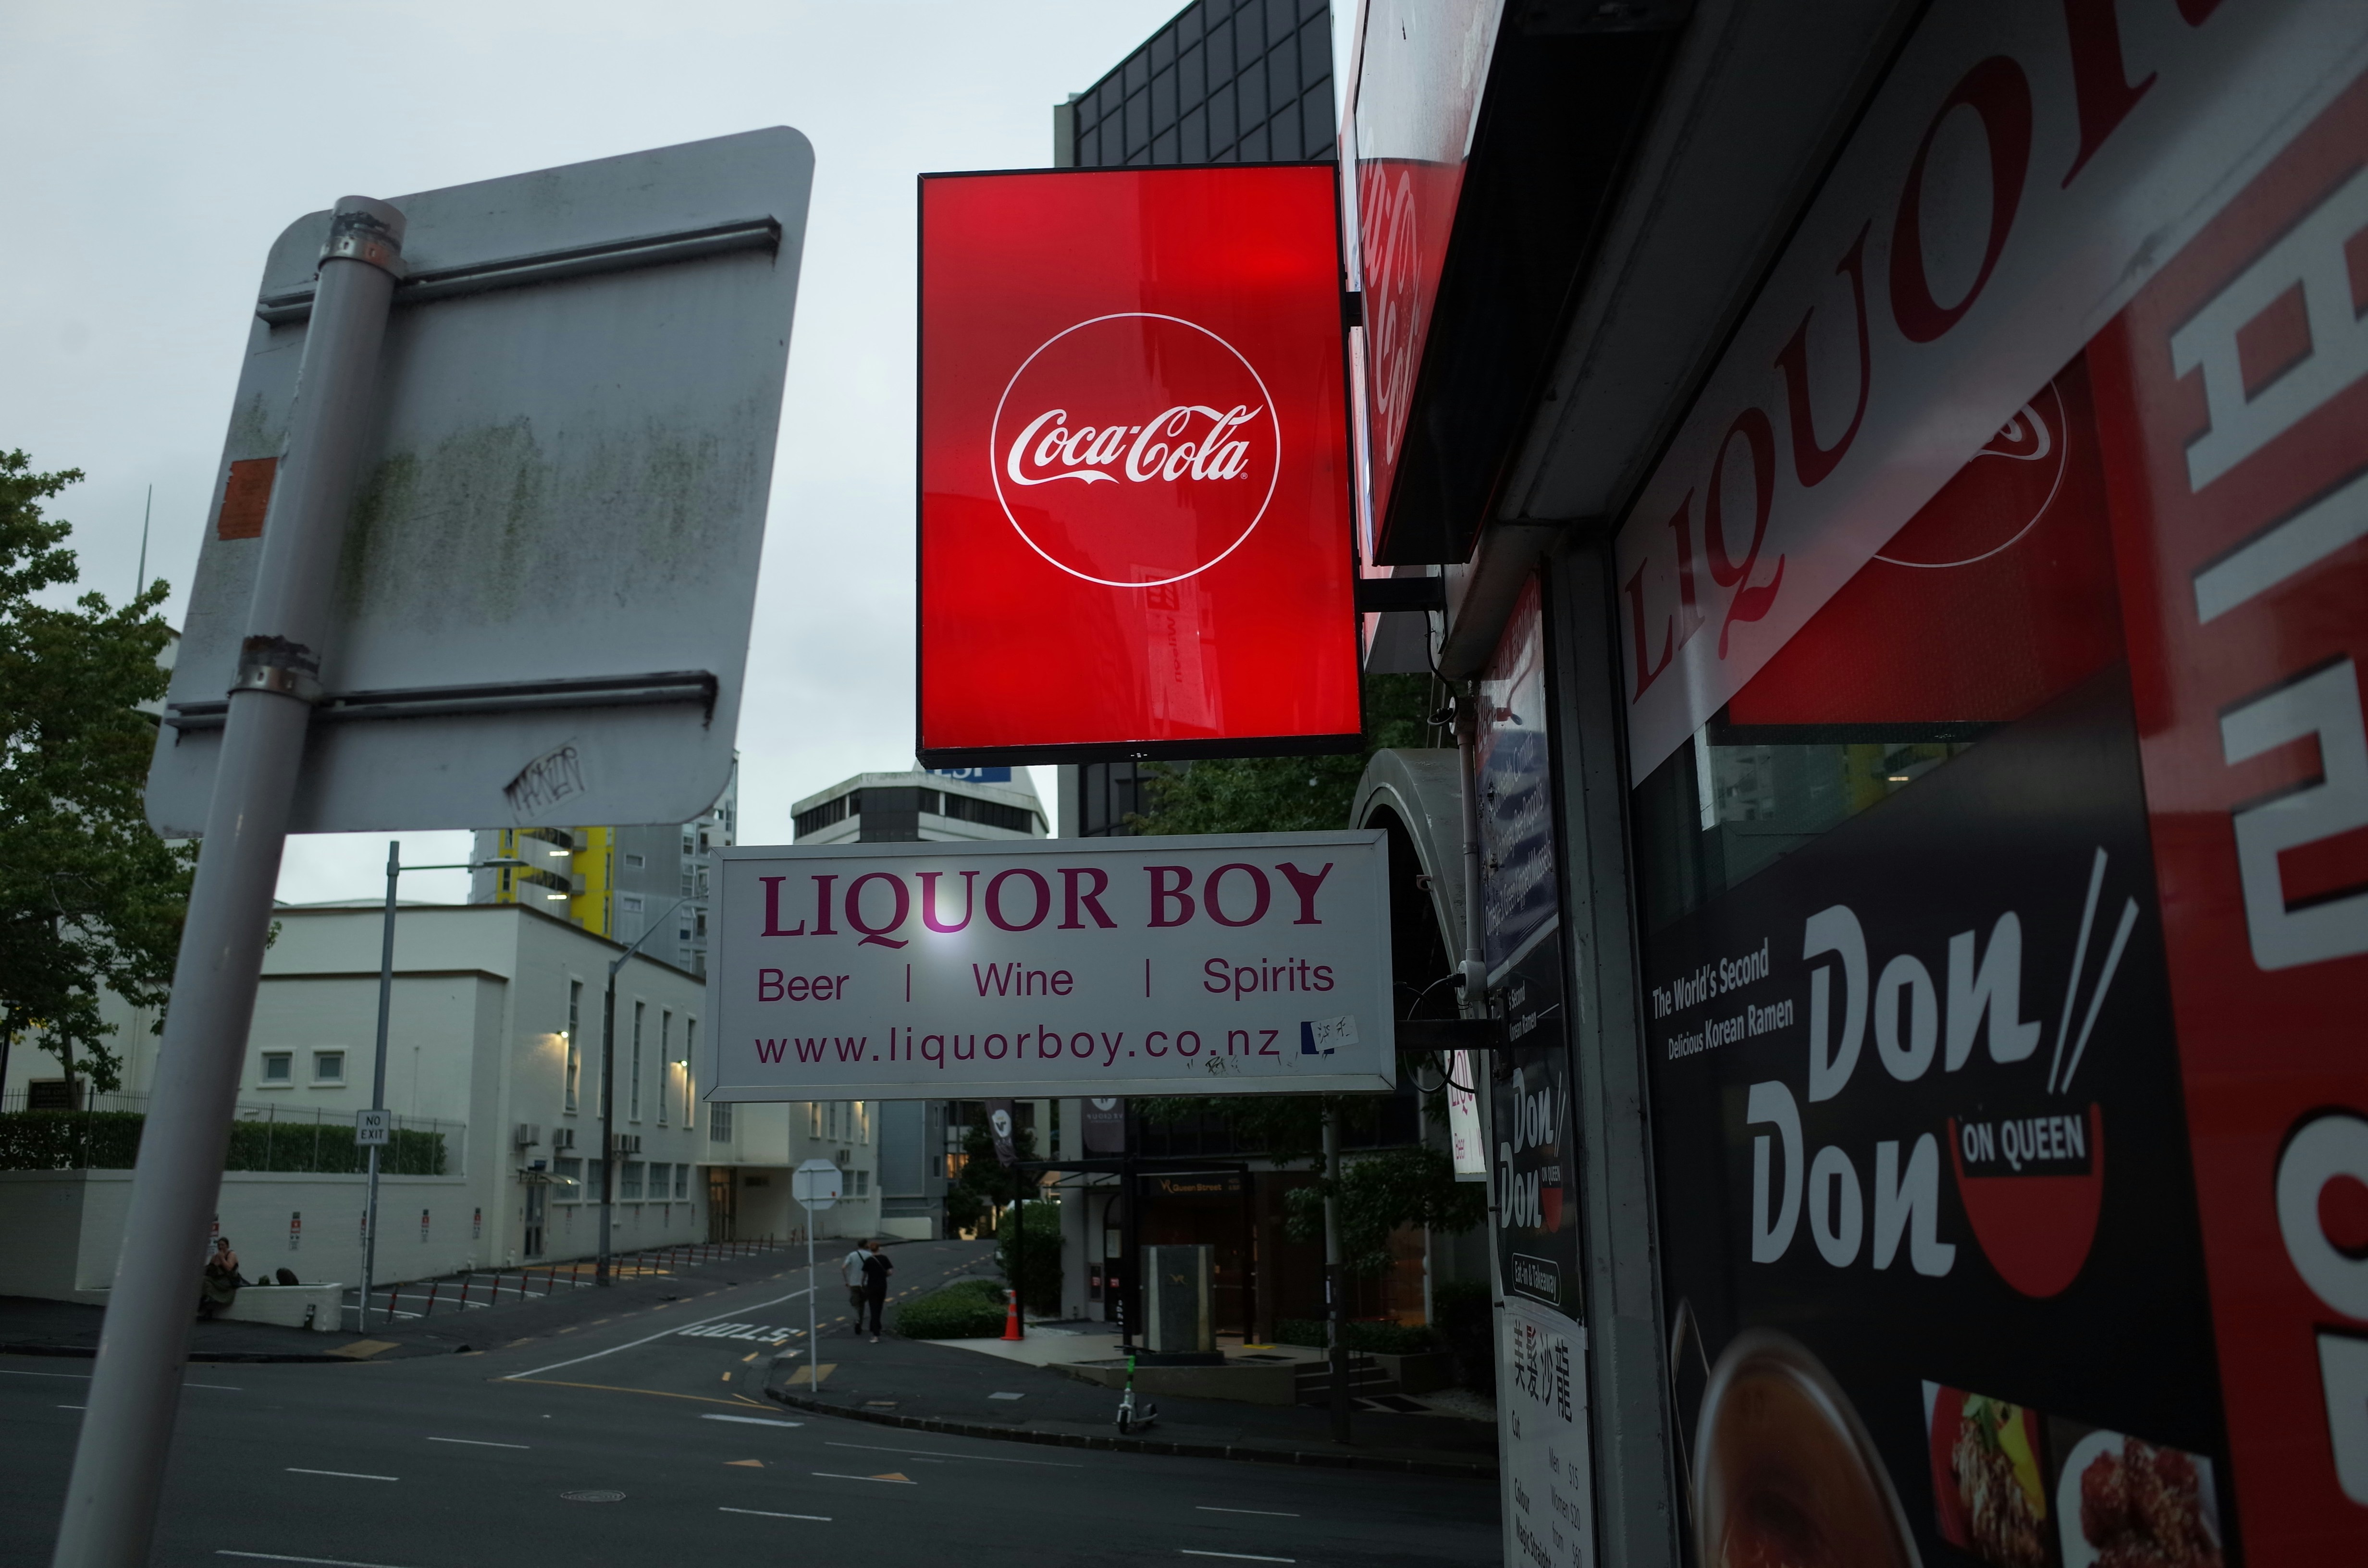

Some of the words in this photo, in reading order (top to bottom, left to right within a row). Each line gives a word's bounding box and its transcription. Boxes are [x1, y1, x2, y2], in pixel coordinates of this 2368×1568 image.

[1008, 404, 1264, 485] Coca-Cola
[759, 868, 1117, 949] LIQUOR
[1143, 862, 1333, 928] BOY
[759, 968, 849, 1002] Beer
[973, 963, 1073, 996] Wine
[1204, 957, 1334, 1001] Spirits
[1653, 986, 1671, 1019] The
[1673, 964, 1716, 1011] World's
[1720, 937, 1769, 993] Second
[1803, 905, 2041, 1102] Don
[755, 1024, 1279, 1068] www.liquorboy.co.nz
[1668, 1031, 1703, 1060] Delicious
[1705, 1016, 1744, 1049] Korean
[1748, 999, 1793, 1037] Ramen
[367, 1116, 380, 1126] NO
[1513, 1067, 1554, 1153] Don
[361, 1129, 383, 1139] EXIT
[1962, 1123, 1995, 1164] ON
[2001, 1114, 2085, 1172] QUEEN
[1500, 1142, 1542, 1228] Don
[1542, 1166, 1547, 1182] ON
[1548, 1165, 1560, 1186] QUEEN
[1747, 1080, 1955, 1277] Don
[1515, 1261, 1528, 1285] Eat-in
[1529, 1263, 1532, 1286] &
[1532, 1264, 1556, 1301] Takeaway
[1512, 1410, 1520, 1440] Cut
[1549, 1446, 1559, 1474] Men
[1569, 1460, 1578, 1490] $15
[1515, 1477, 1529, 1515] Colour
[1551, 1483, 1569, 1521] Women
[1571, 1500, 1580, 1531] $20
[1516, 1513, 1529, 1554] Magic
